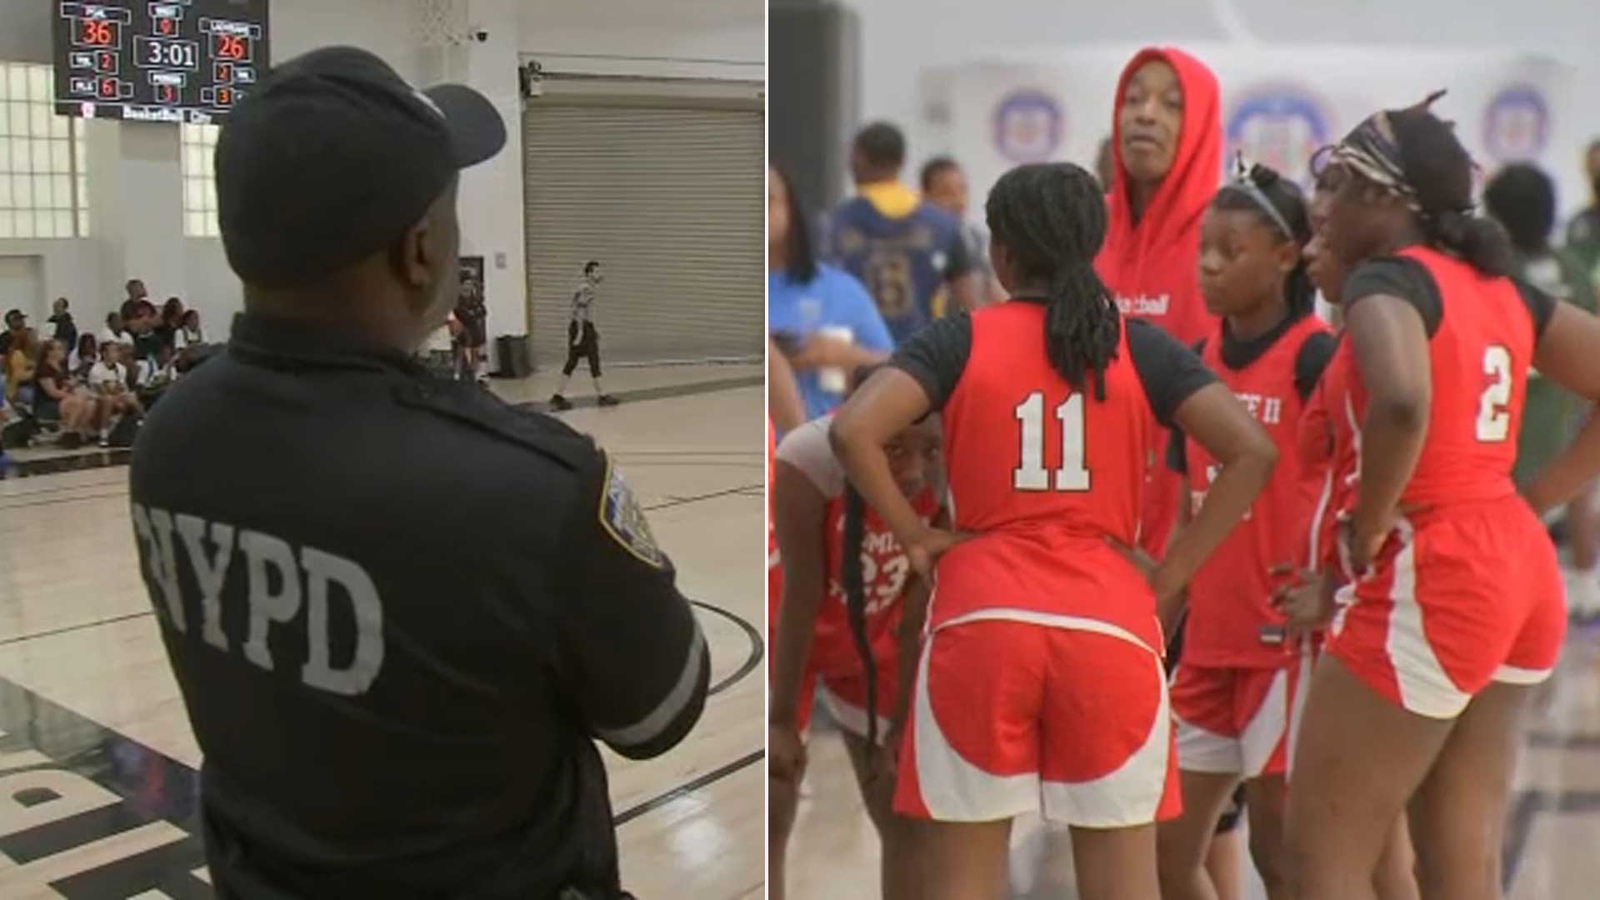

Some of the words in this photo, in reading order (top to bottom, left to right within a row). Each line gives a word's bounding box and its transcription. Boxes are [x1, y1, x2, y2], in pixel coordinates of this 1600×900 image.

[83, 21, 111, 44] 36
[149, 42, 194, 66] 3:01
[218, 36, 244, 59] 26
[102, 79, 113, 95] 6
[219, 88, 229, 102] 3
[1475, 344, 1511, 442] 2
[1013, 391, 1091, 491] 11
[131, 503, 384, 696] NYPD
